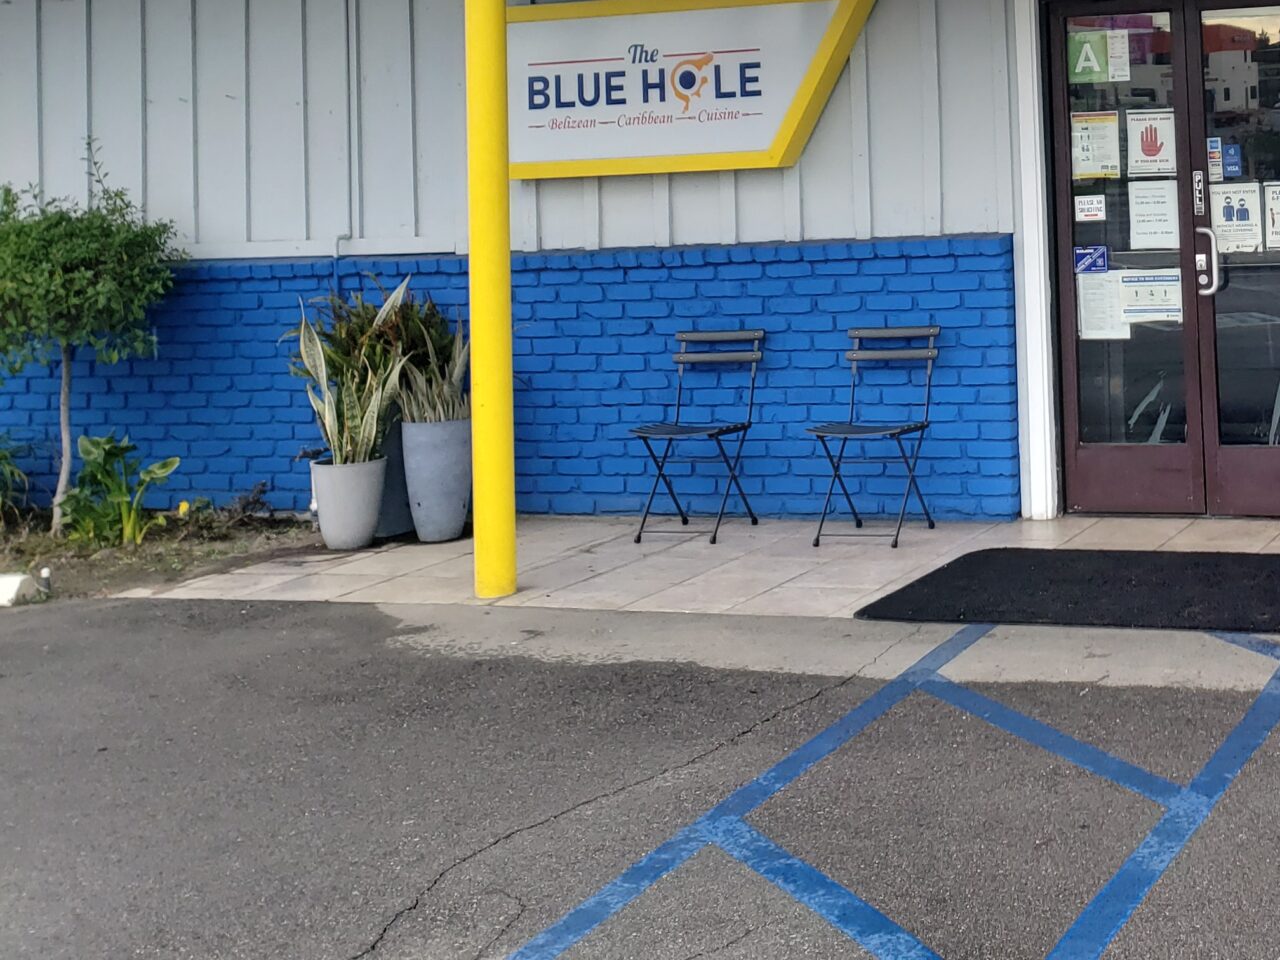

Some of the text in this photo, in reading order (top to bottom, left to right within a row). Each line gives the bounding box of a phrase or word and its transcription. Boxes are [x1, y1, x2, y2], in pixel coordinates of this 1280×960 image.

[627, 43, 660, 65] The
[1074, 42, 1102, 73] A
[527, 60, 763, 111] BLUE HOLE
[548, 107, 741, 131] Belizean Caribbean Cuisine
